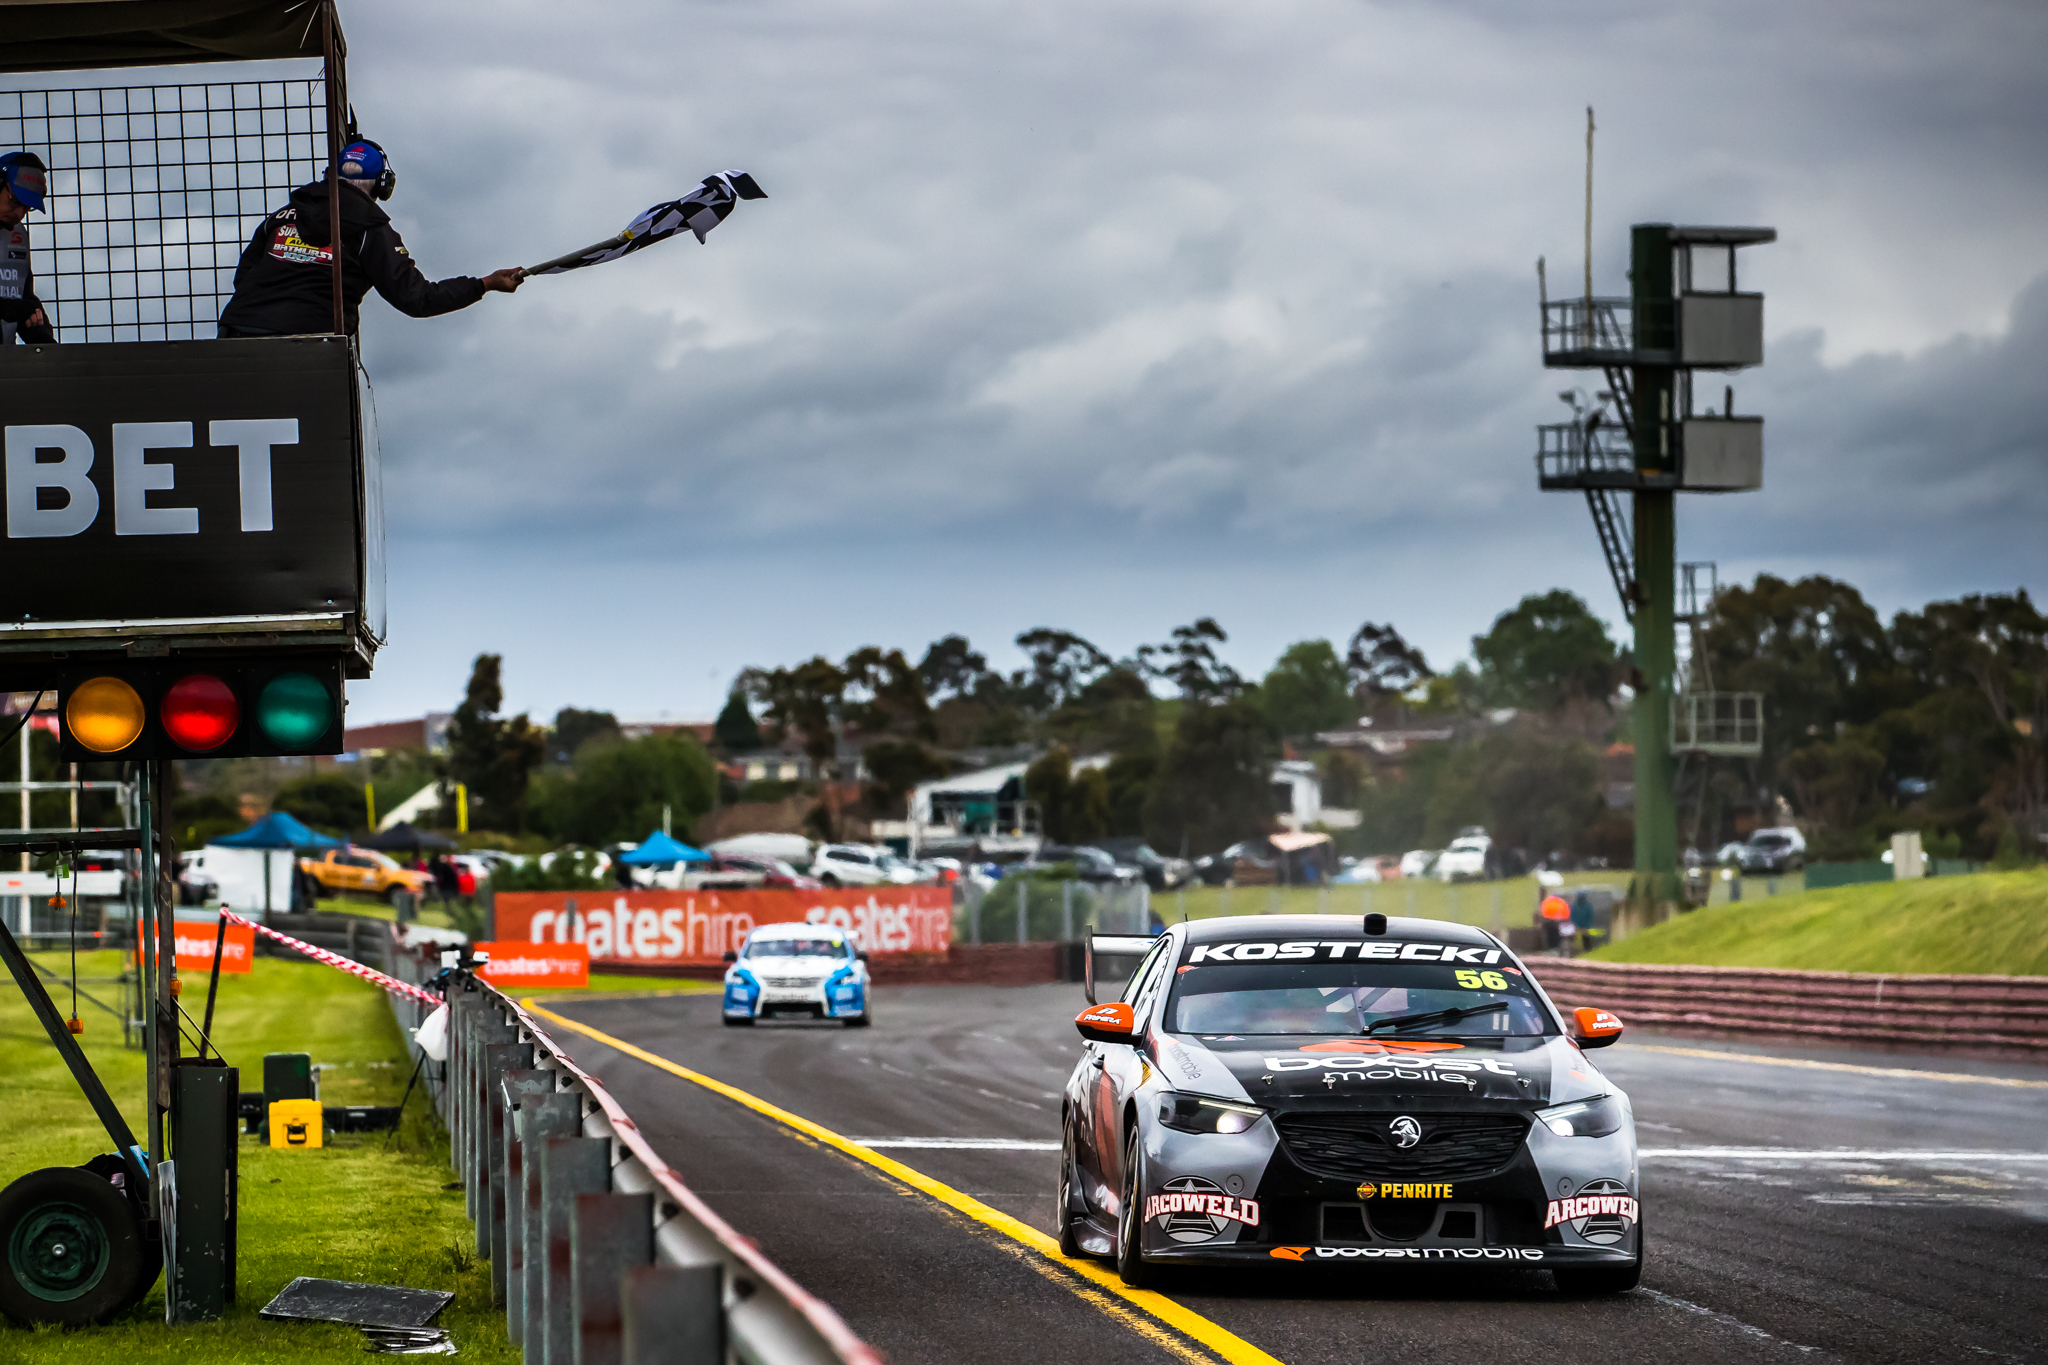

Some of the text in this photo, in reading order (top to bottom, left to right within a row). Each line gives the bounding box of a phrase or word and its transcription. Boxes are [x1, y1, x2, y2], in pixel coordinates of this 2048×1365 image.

[5, 418, 300, 538] BET
[1189, 941, 1501, 964] KOSTECKI
[1454, 969, 1508, 990] 56
[1264, 1055, 1518, 1076] boost
[1325, 1068, 1467, 1083] mobile
[1381, 1183, 1453, 1199] PENRITE
[1144, 1193, 1259, 1227] ARCOWELD
[1315, 1246, 1544, 1261] boostmobile
